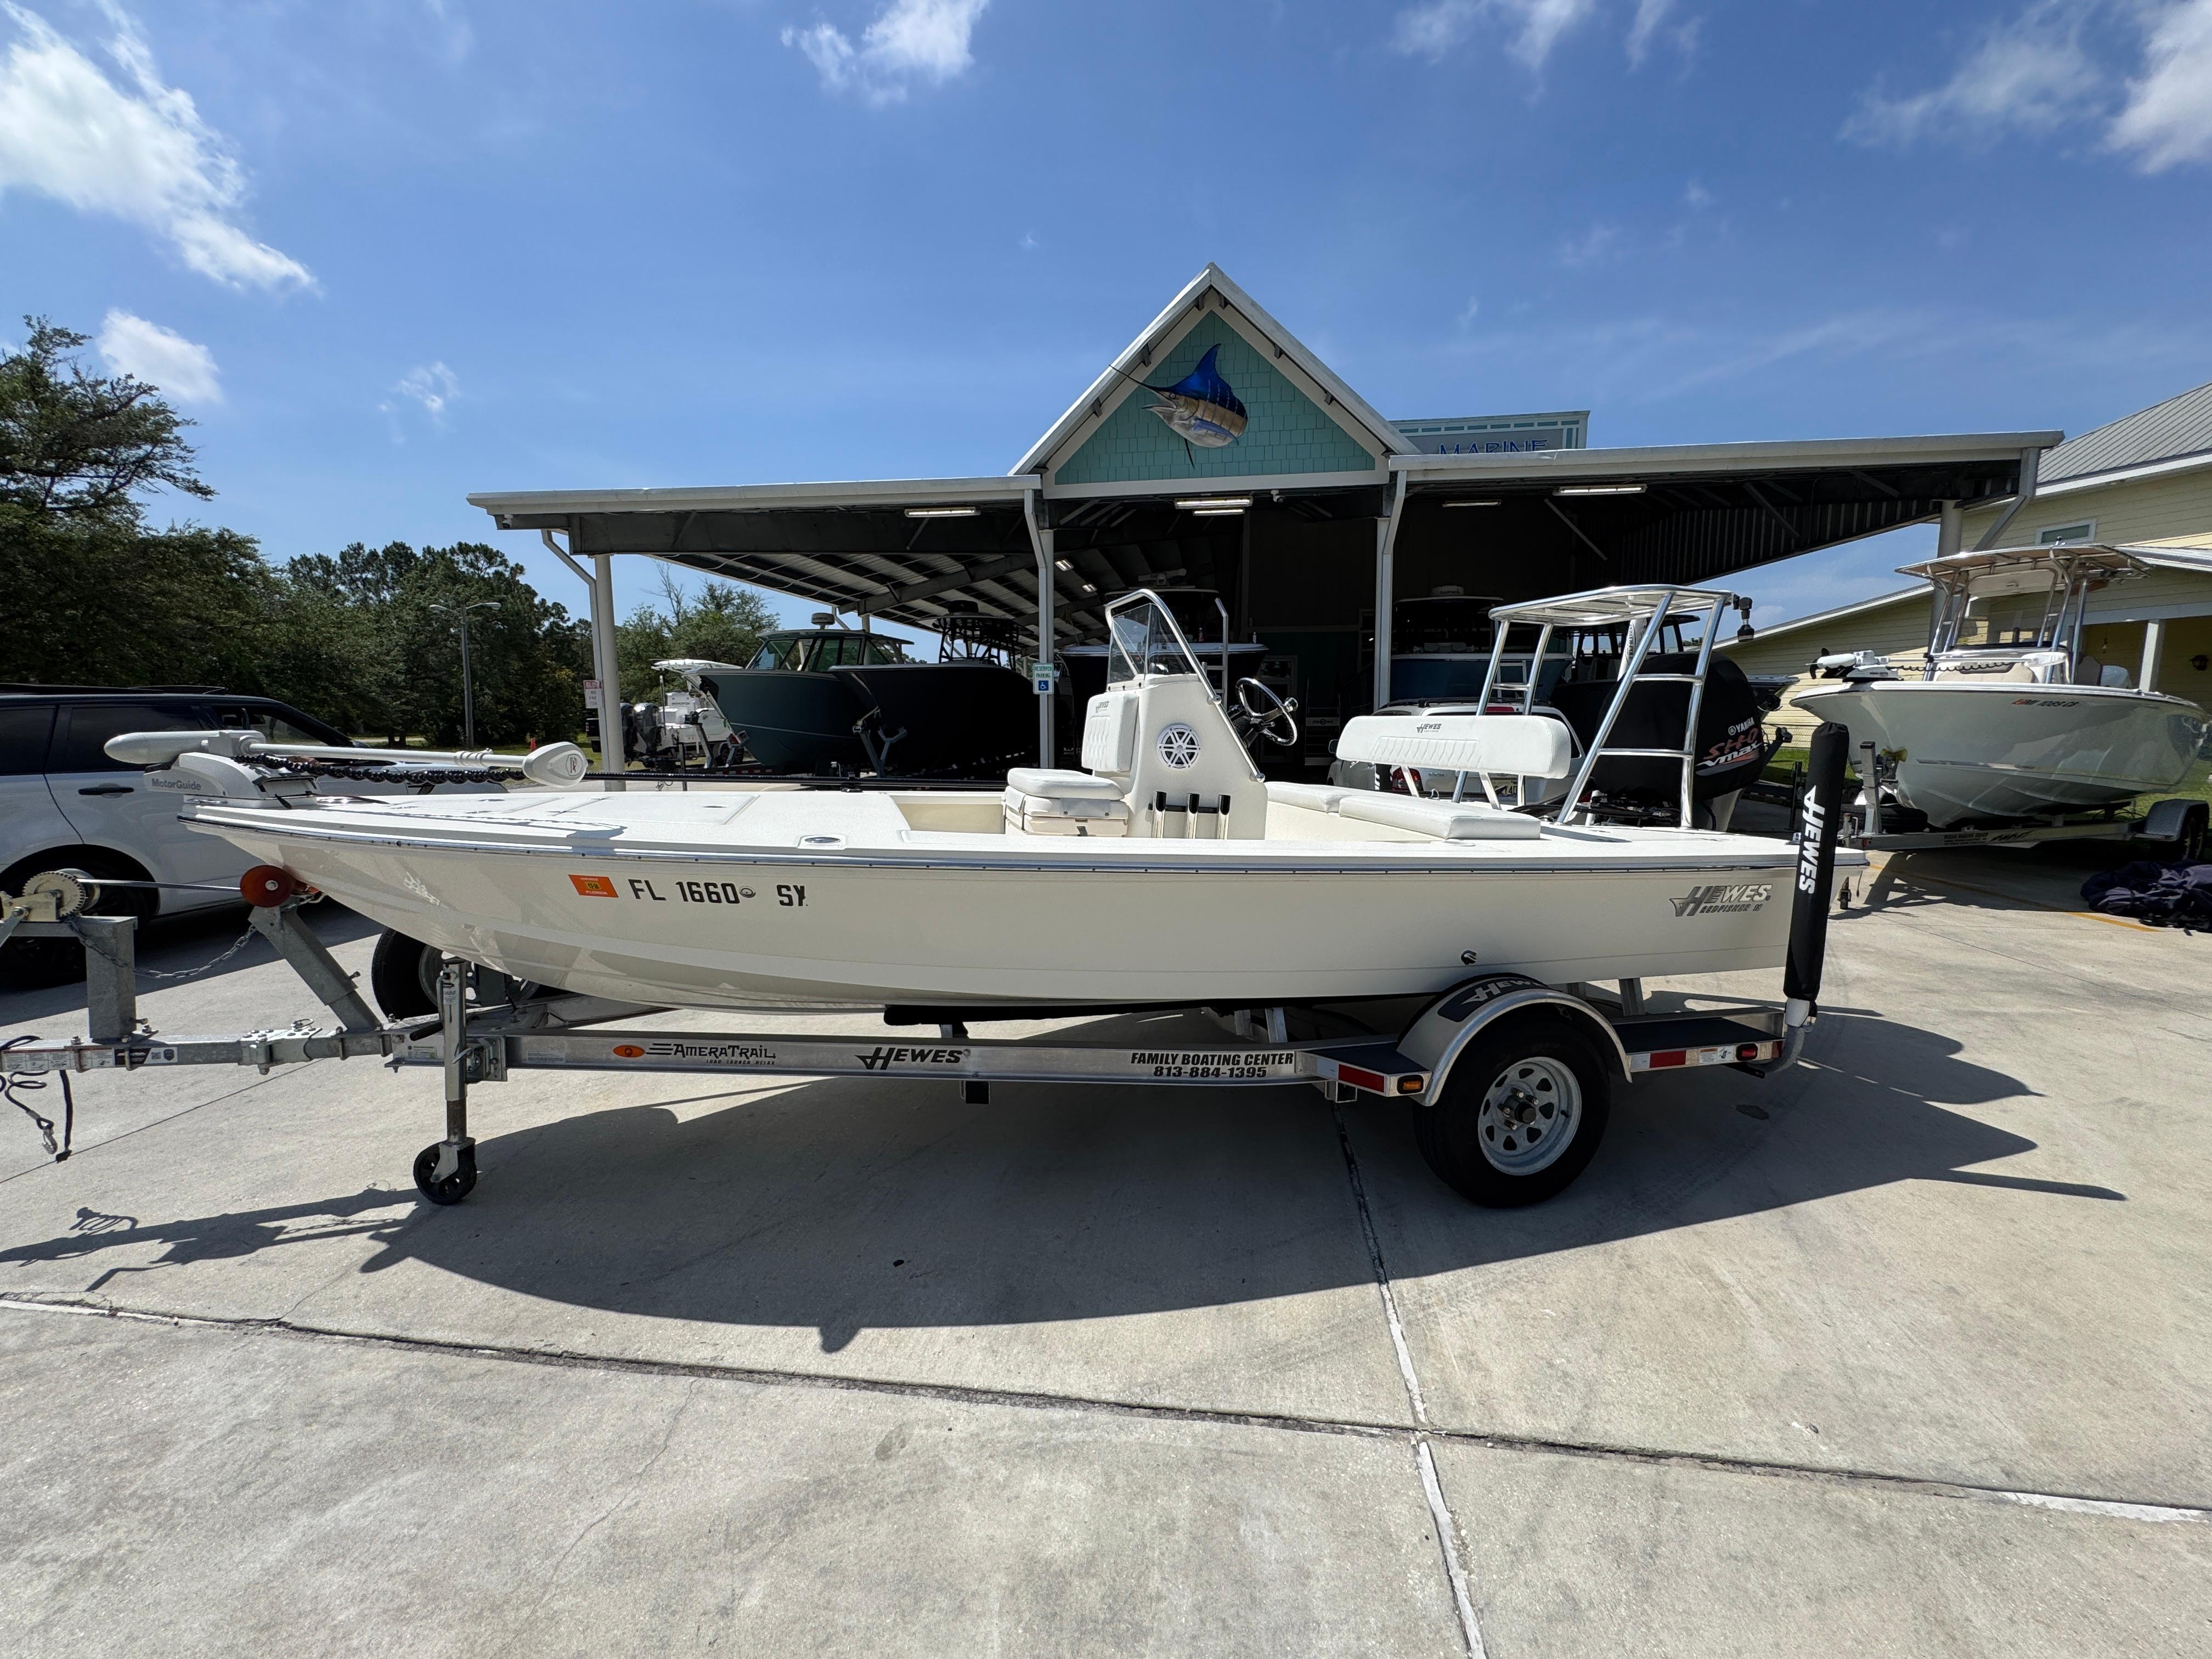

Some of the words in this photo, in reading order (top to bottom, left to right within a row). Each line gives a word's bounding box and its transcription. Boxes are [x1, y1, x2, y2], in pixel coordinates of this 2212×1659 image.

[1416, 723, 1442, 733] HEWES
[151, 778, 202, 791] MotorGuide
[1798, 785, 1826, 894] HEWES
[628, 878, 667, 901] FL
[675, 881, 741, 904] 1660
[854, 1047, 963, 1070] HEWES
[1130, 1052, 1180, 1065] FAMILY
[1181, 1053, 1242, 1066] BOATING
[1244, 1052, 1294, 1066] CENTER
[1153, 1065, 1267, 1078] 813-884-1395
